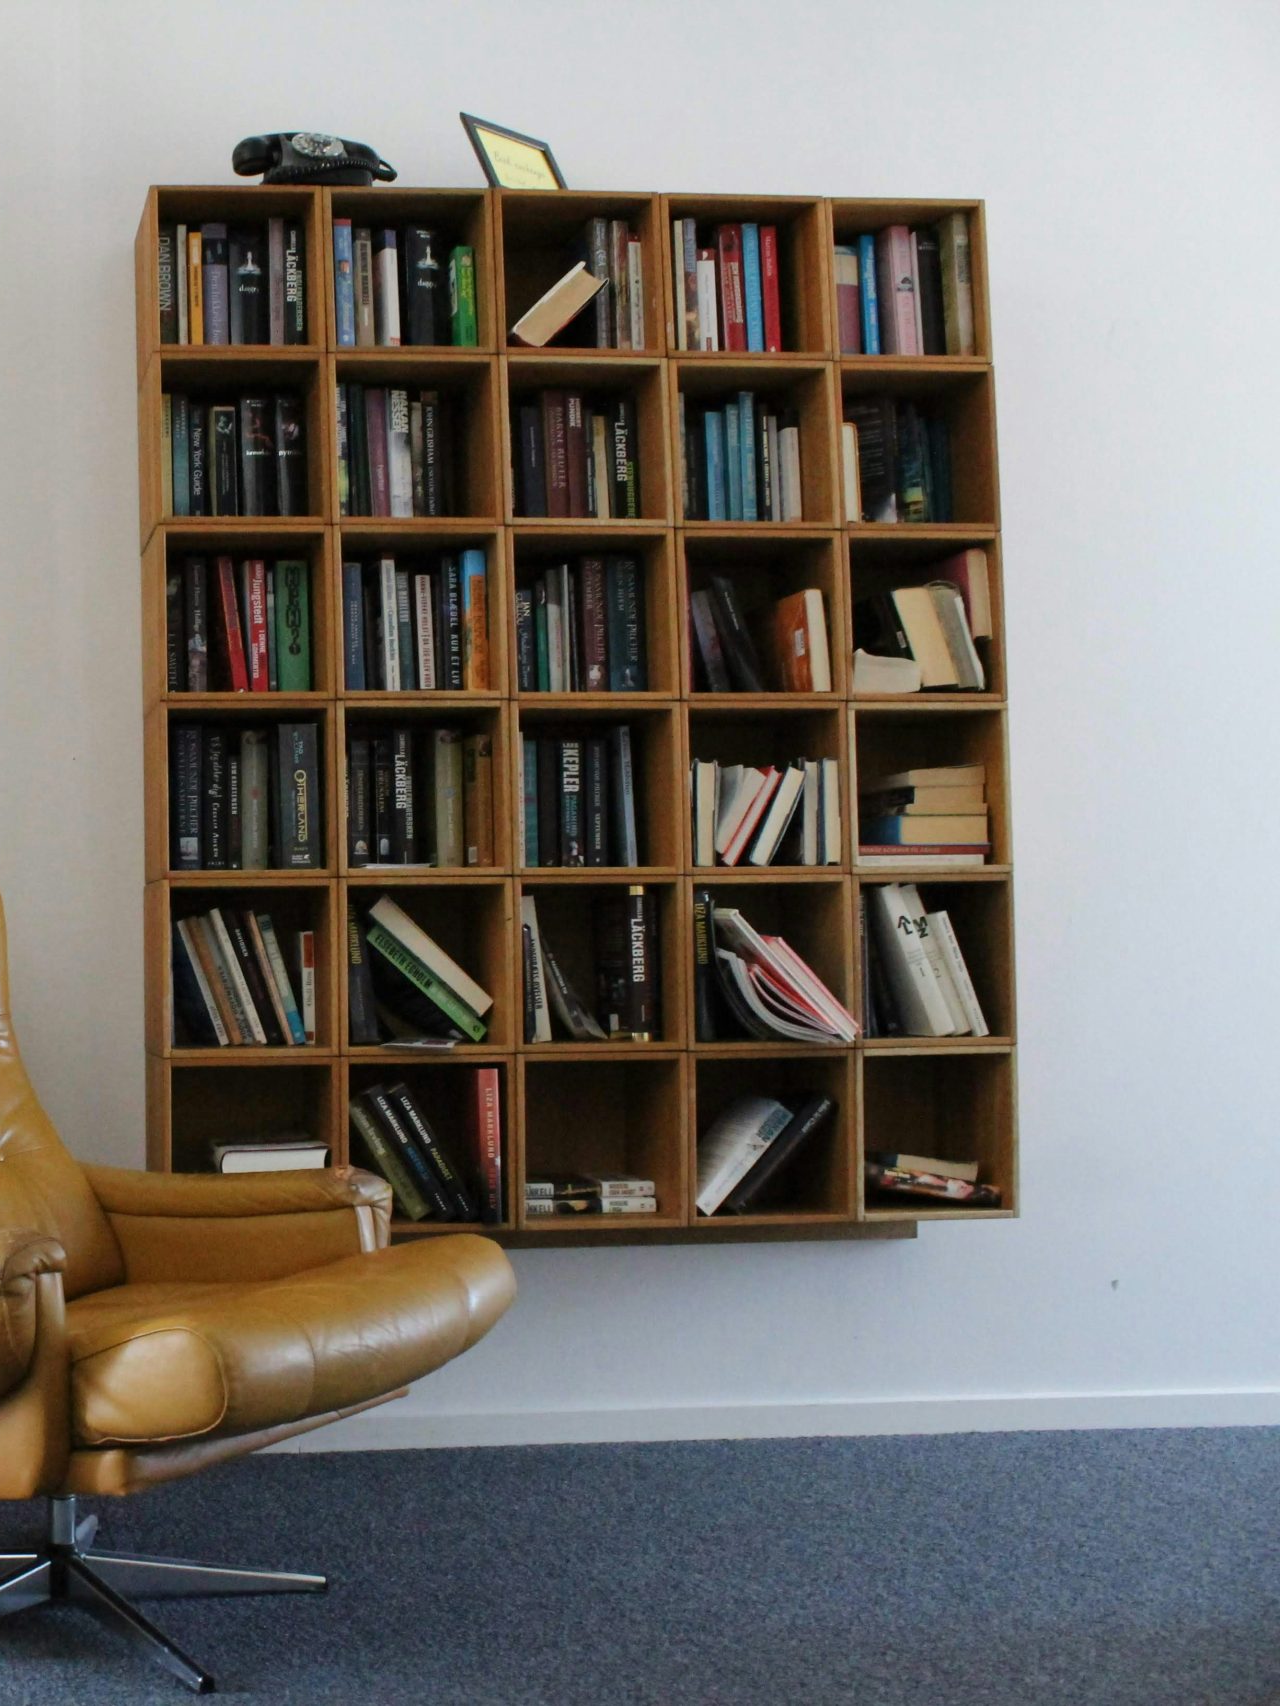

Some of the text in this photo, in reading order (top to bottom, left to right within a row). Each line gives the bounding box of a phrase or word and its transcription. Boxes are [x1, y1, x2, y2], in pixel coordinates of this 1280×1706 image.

[159, 237, 171, 311] DAN BROWN
[286, 250, 298, 302] LÄCKBERG
[193, 428, 202, 495] New York Guide
[426, 428, 434, 464] GRISHAM
[615, 422, 628, 481] LÄCKBERG
[251, 579, 263, 624] Jungstedt
[448, 567, 460, 684] SARA BLÆDEL KUN ET LIV
[394, 755, 407, 809] LÄCKBERG
[562, 749, 580, 792] KEPLER
[187, 795, 199, 834] PILCHER
[294, 770, 308, 842] OTHERLAND
[695, 903, 705, 919] LIZA
[631, 918, 645, 982] LÄCKBERG
[377, 1096, 408, 1144] LIZA MARKLUND
[400, 1096, 412, 1110] LIZA
[408, 1111, 431, 1144] MARKLUND
[485, 1088, 493, 1108] LIZA
[487, 1111, 495, 1158] MARKLUND
